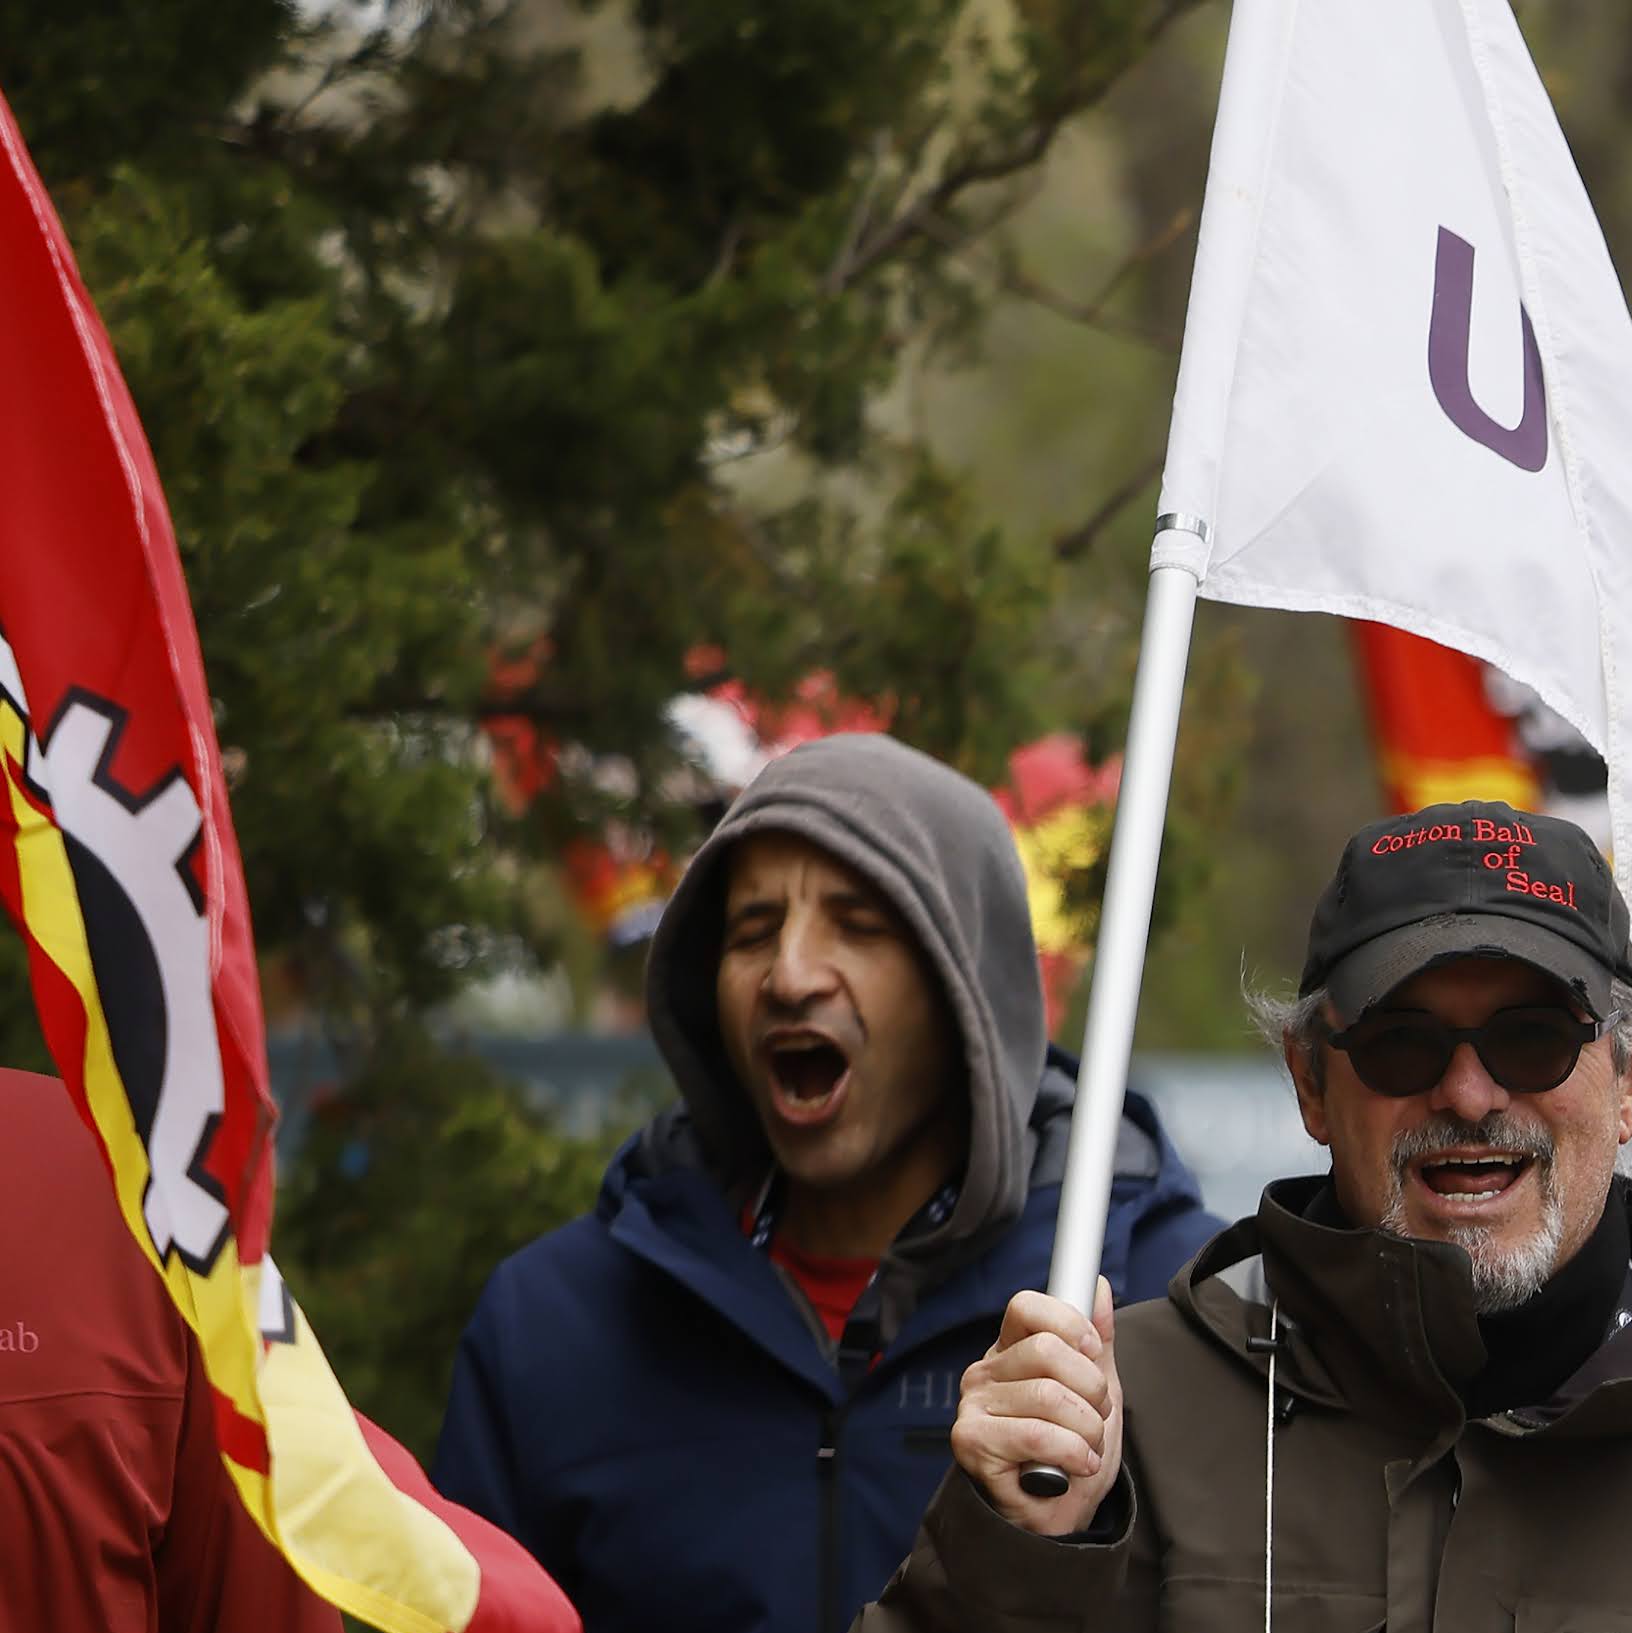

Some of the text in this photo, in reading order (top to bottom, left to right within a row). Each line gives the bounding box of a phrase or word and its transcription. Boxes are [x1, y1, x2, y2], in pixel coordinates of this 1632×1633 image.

[1370, 818, 1537, 855] Cotton Ball
[1483, 845, 1521, 870] of
[1505, 871, 1578, 911] Seal
